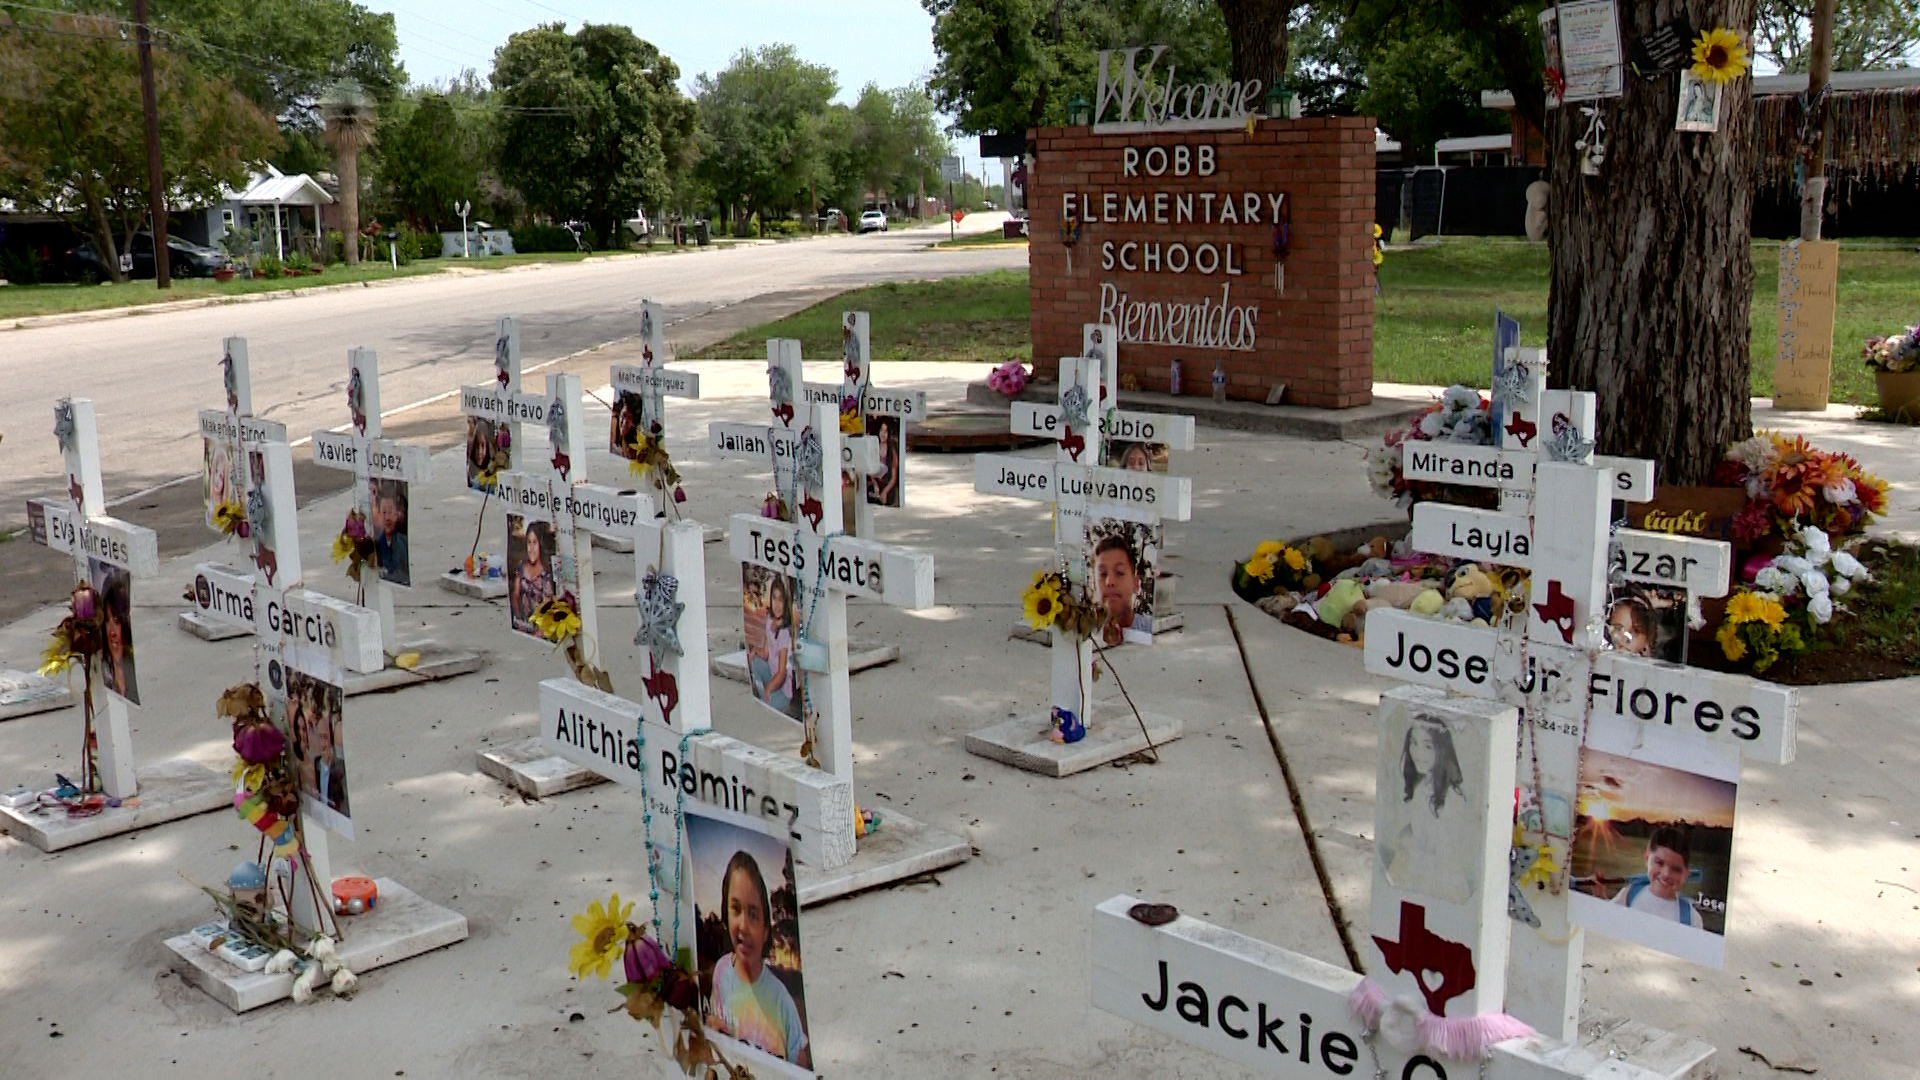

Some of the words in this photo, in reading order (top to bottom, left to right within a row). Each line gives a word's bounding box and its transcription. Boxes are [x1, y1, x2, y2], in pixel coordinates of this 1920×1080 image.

[1096, 45, 1263, 125] Welcome
[1123, 144, 1217, 178] ROBB
[1062, 192, 1285, 224] ELEMENTARY
[1102, 241, 1243, 275] SCHOOL
[1100, 282, 1258, 351] Bienvenidos
[507, 399, 543, 420] Bravo
[864, 394, 912, 414] orres
[1032, 411, 1057, 431] Le
[318, 441, 358, 463] Xavier
[366, 443, 402, 472] Lopez
[718, 432, 765, 454] Jailah
[1411, 452, 1514, 480] Miranda
[998, 467, 1048, 491] Jayce
[1061, 477, 1156, 504] Luevanos
[565, 497, 637, 527] Rodriguez
[1644, 509, 1707, 535] light
[52, 516, 75, 546] Eva
[80, 527, 129, 563] Mireles
[1451, 523, 1529, 557] Layla
[1615, 549, 1698, 582] azar
[750, 530, 805, 570] Tess
[818, 547, 884, 594] Mata
[210, 581, 254, 621] Irma
[268, 601, 337, 648] Garcia
[1386, 631, 1489, 684] Jose
[1513, 655, 1560, 694] Jr
[1588, 673, 1761, 741] Flores
[556, 707, 642, 772] Alithia
[662, 750, 802, 841] Ramirez
[1141, 960, 1358, 1075] Jackie
